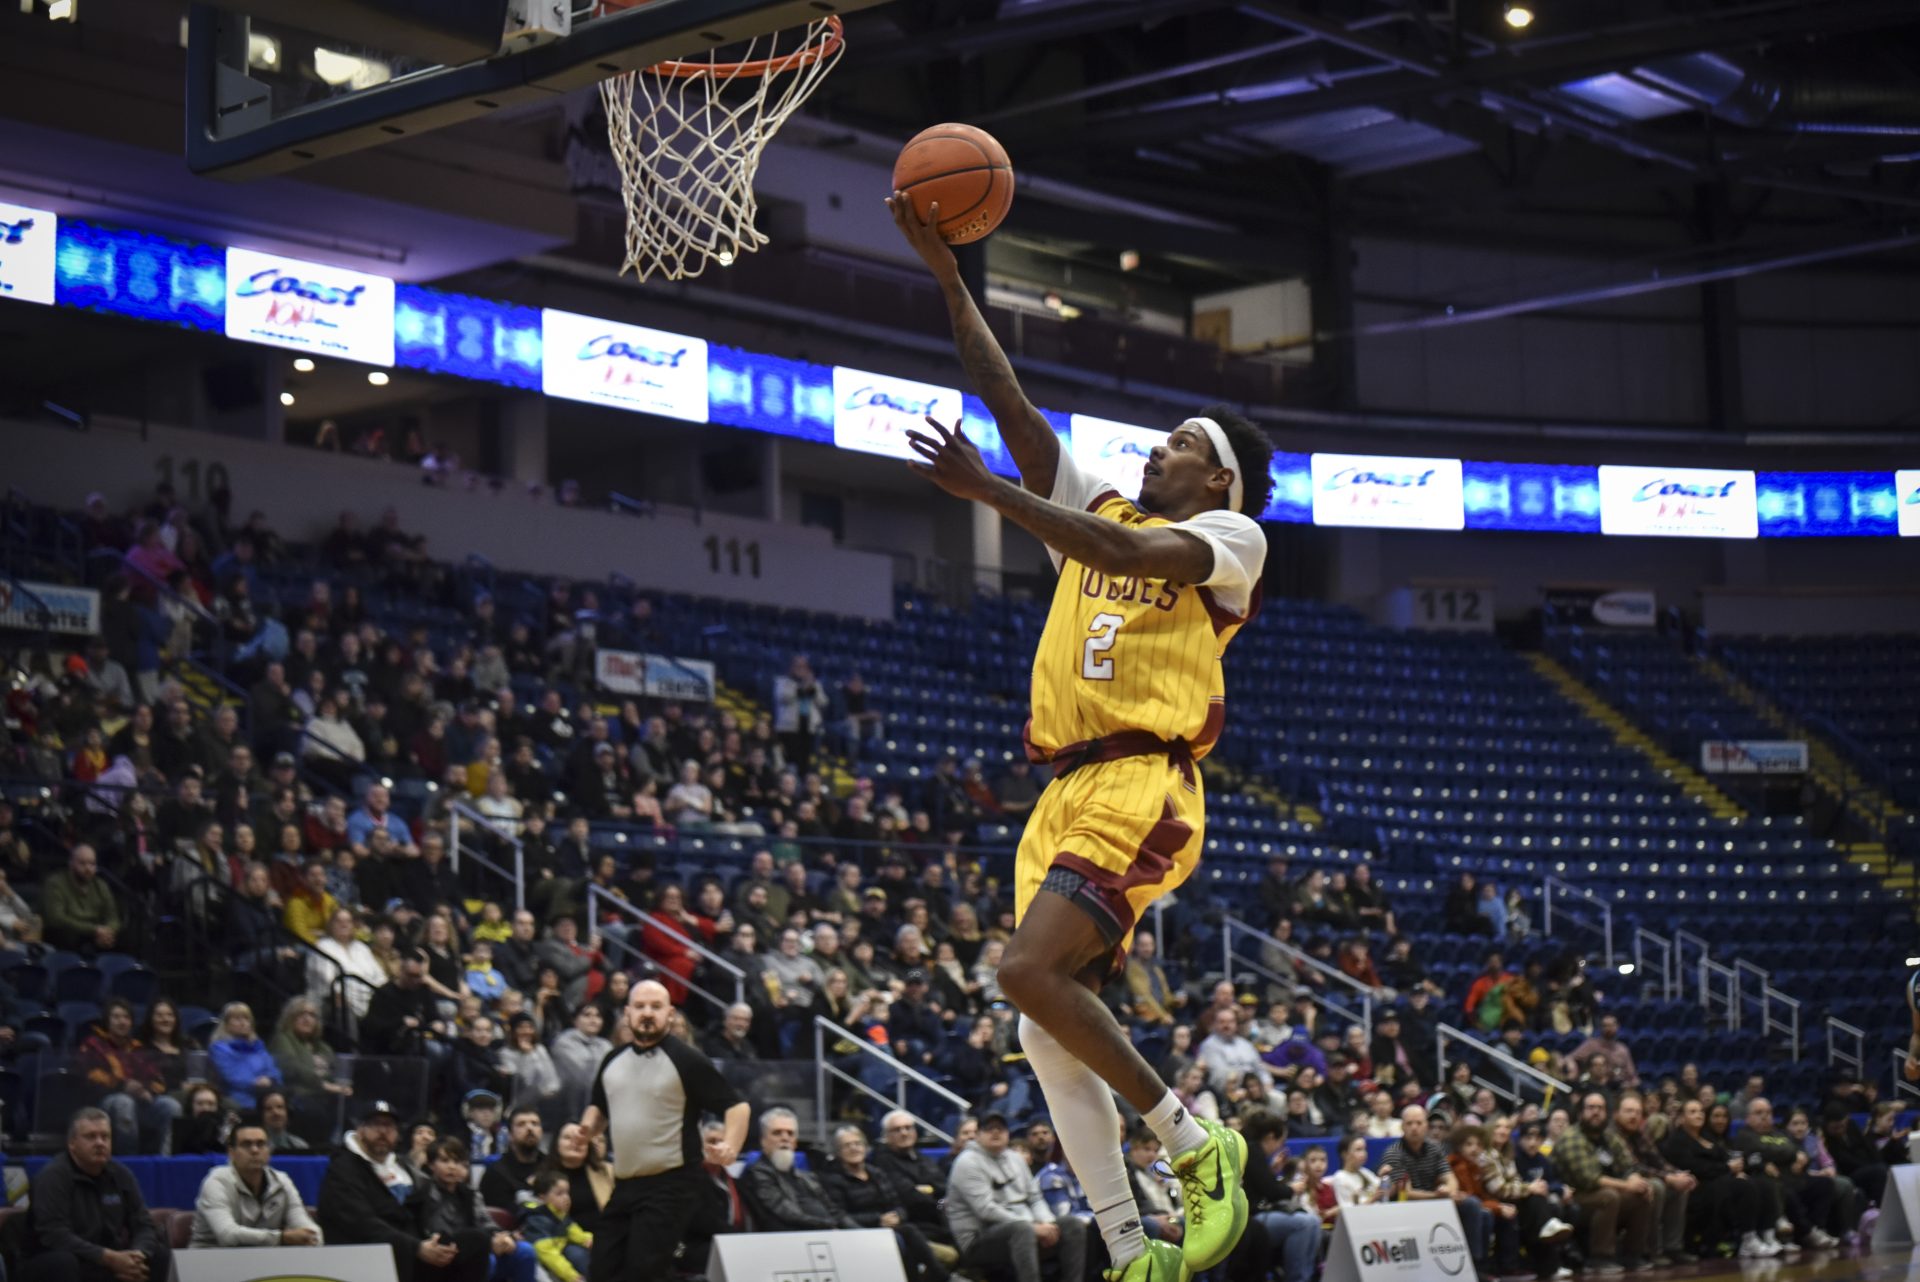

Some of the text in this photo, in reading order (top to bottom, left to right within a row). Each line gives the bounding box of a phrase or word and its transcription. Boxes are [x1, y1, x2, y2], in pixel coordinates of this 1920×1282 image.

[704, 535, 761, 579] 111
[1420, 590, 1481, 622] 112
[1082, 612, 1126, 681] 2
